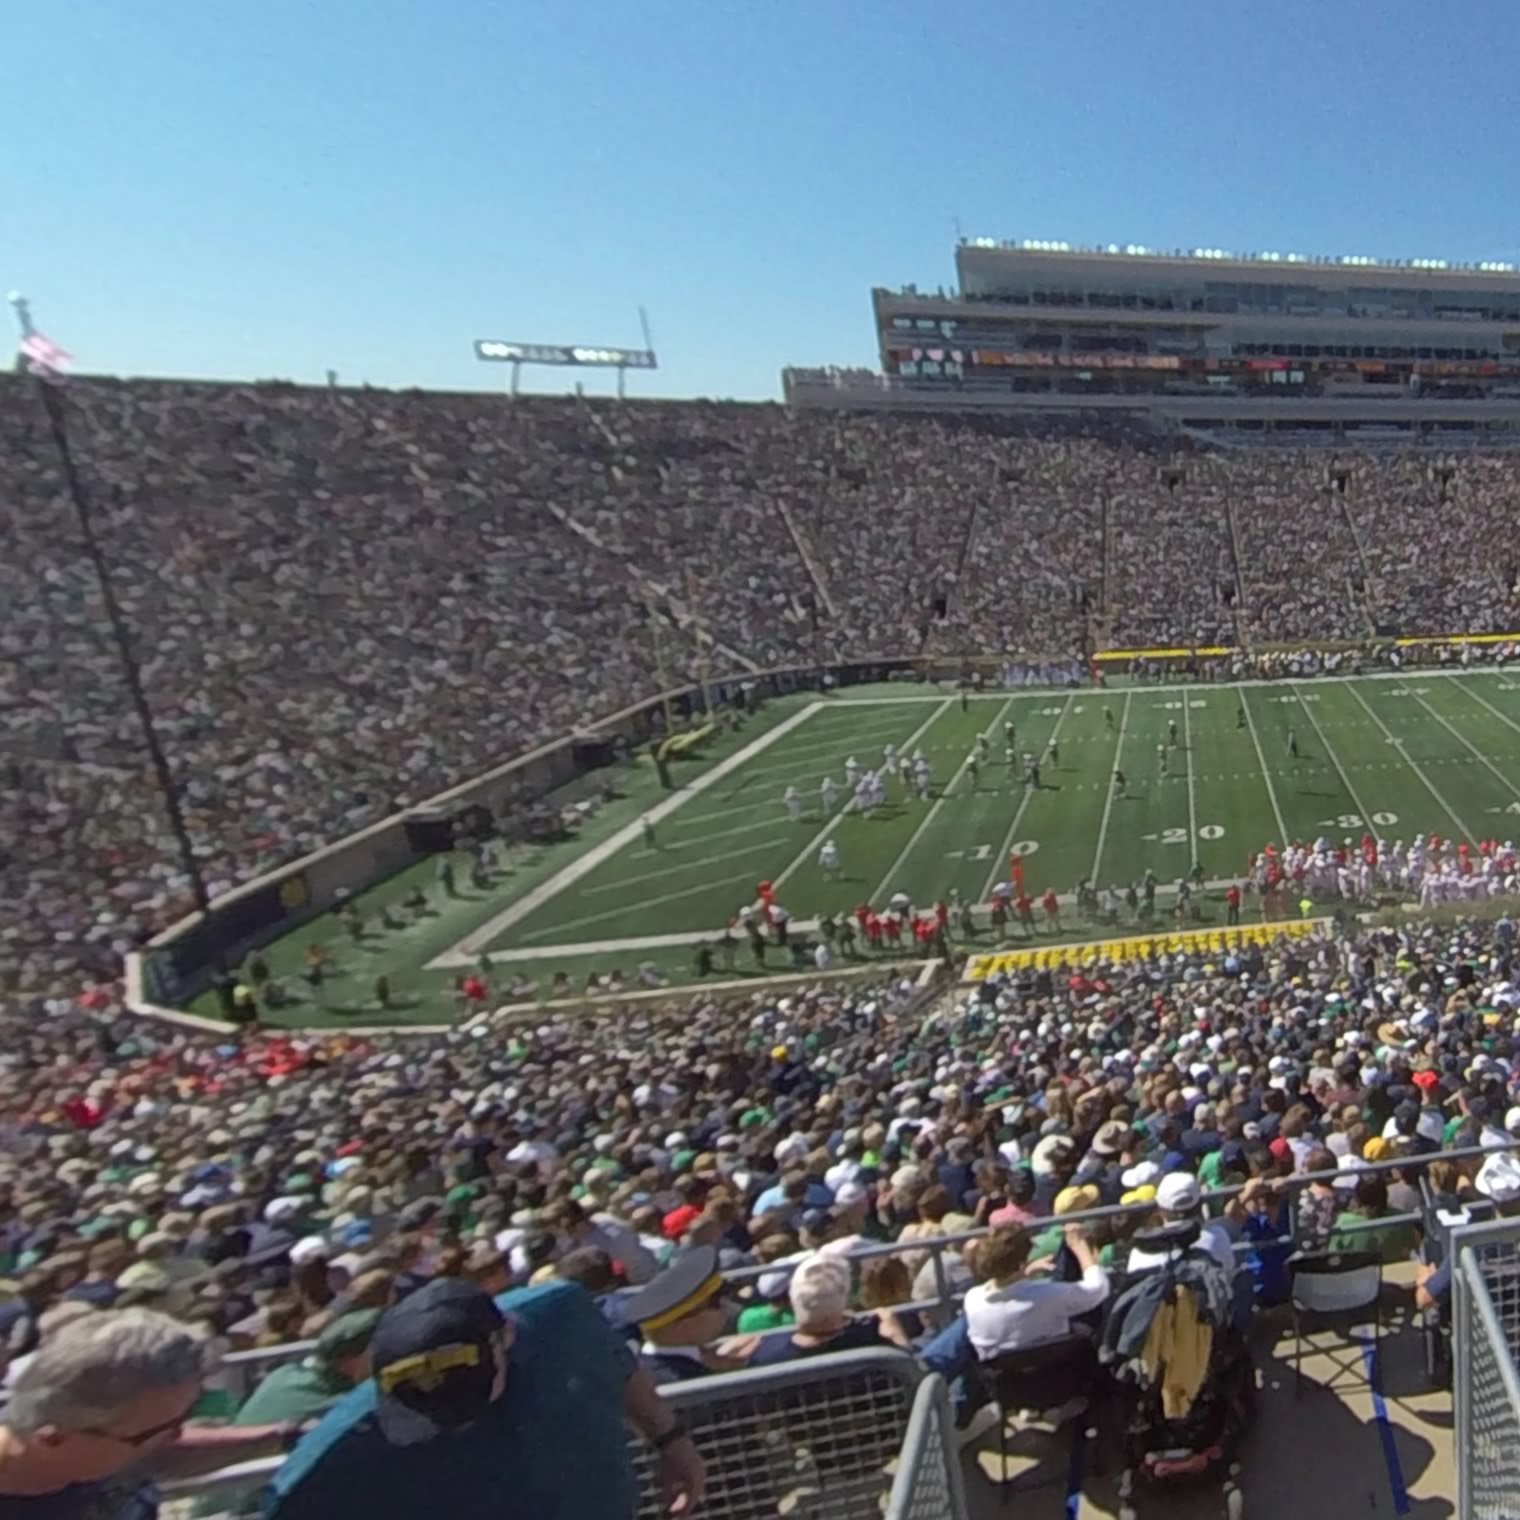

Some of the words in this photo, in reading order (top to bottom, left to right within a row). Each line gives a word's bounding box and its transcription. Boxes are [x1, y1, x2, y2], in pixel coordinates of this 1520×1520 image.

[1337, 811, 1398, 829] 30
[1160, 825, 1225, 844] 20
[967, 840, 1039, 860] 10
